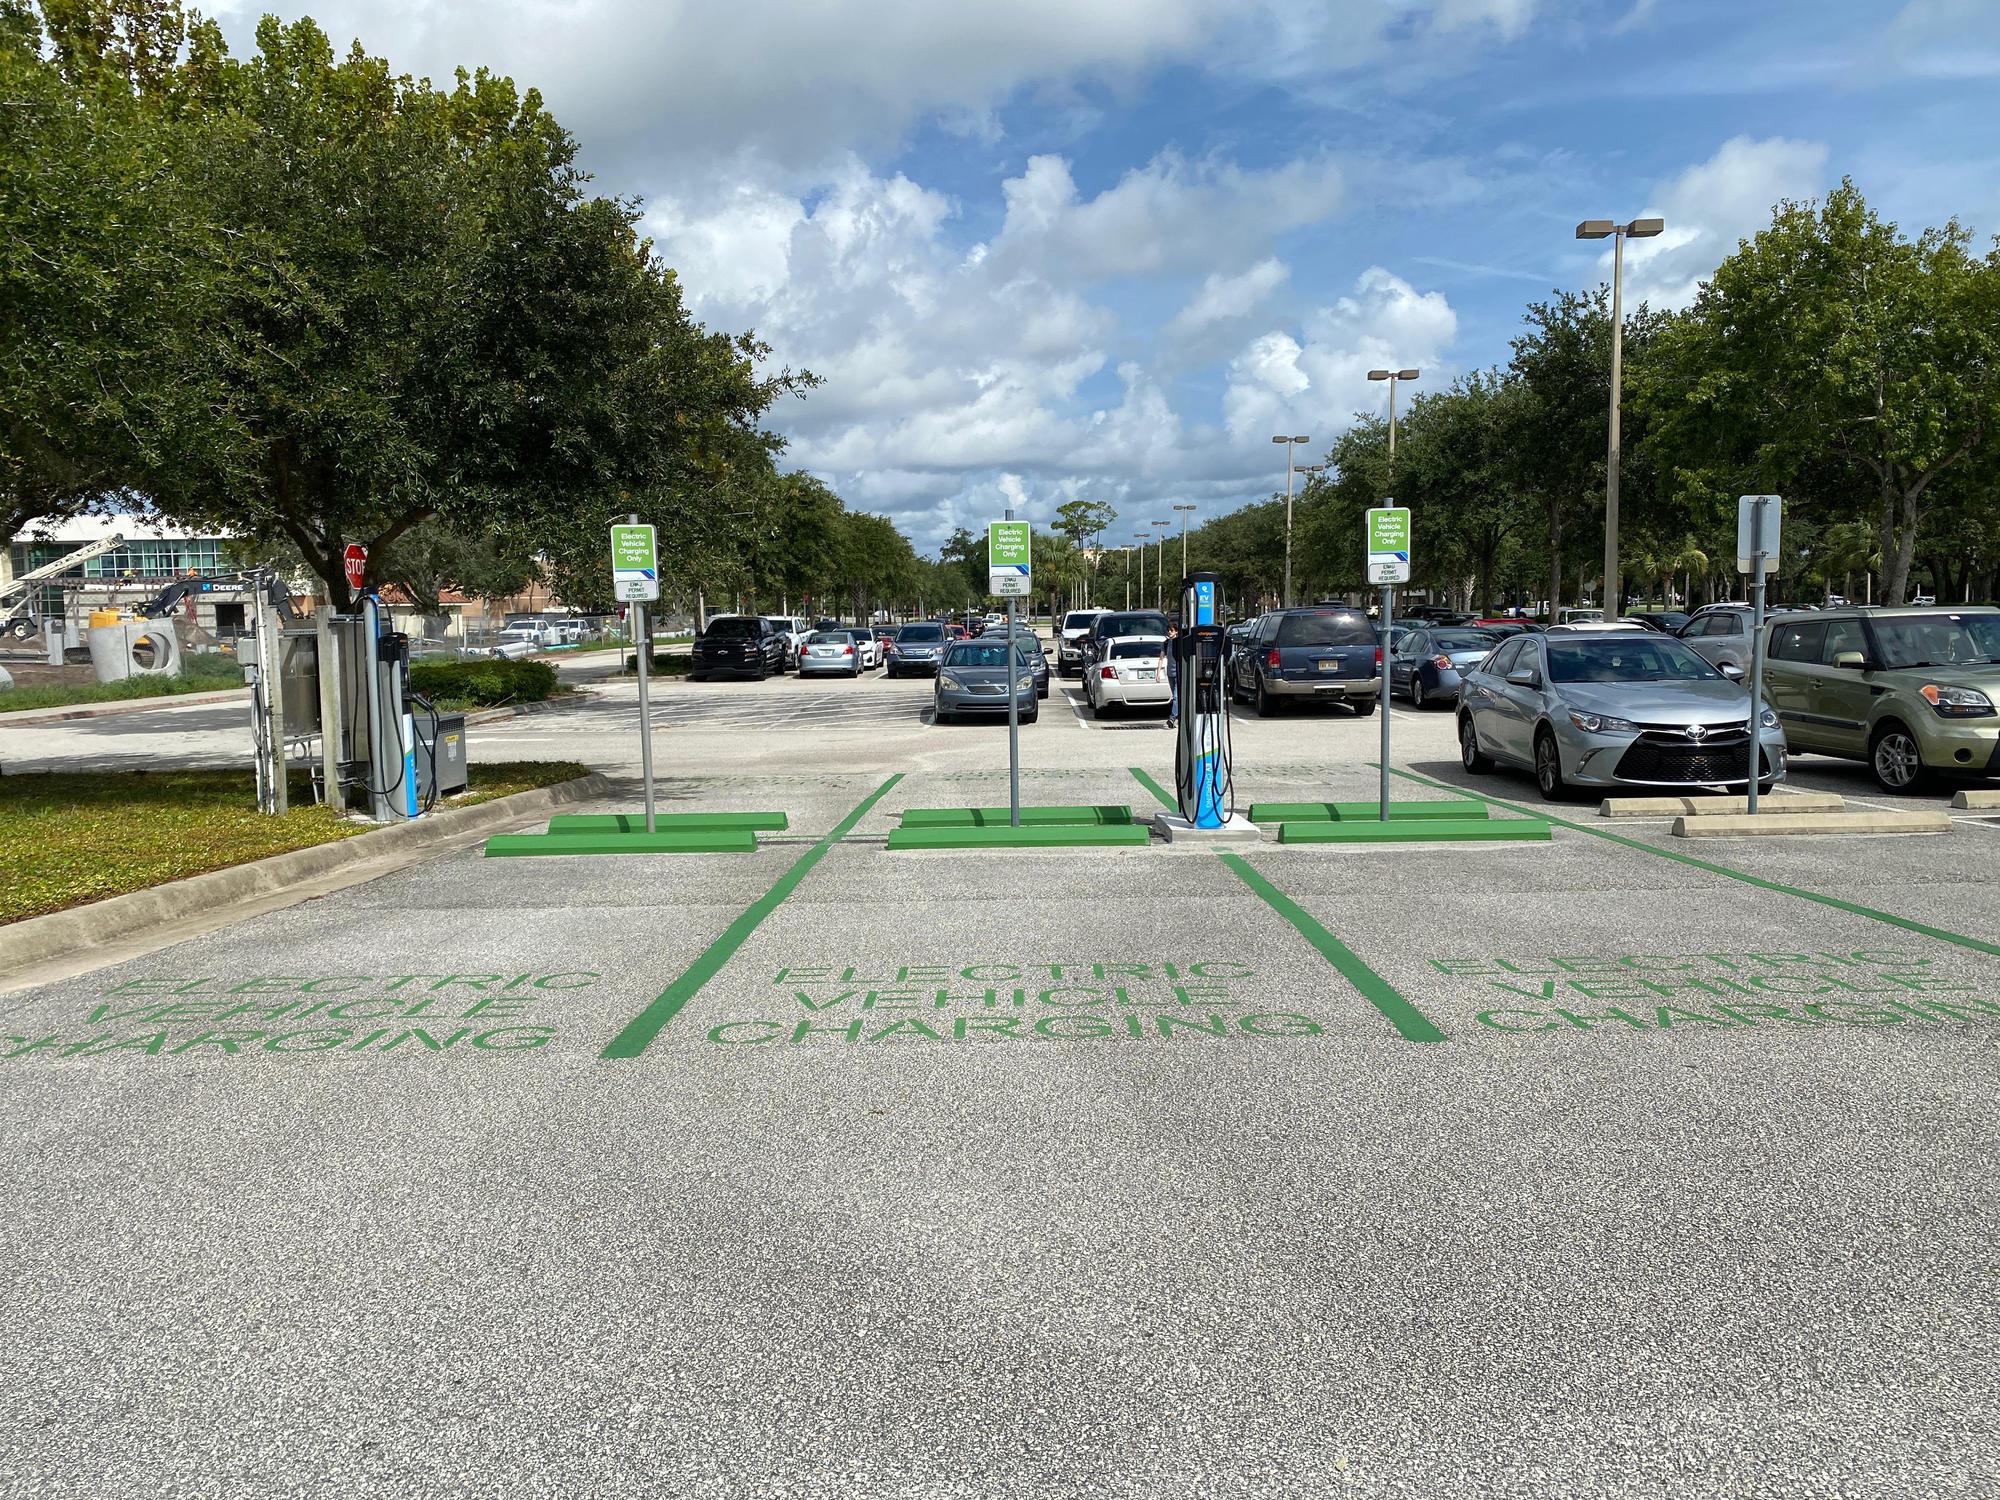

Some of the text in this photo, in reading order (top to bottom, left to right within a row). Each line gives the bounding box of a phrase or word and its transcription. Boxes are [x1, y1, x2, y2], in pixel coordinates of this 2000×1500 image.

[618, 548, 649, 556] Charging
[995, 543, 1024, 551] Charging
[347, 558, 366, 575] STOP
[772, 962, 1252, 986] ELECTRIC
[1428, 950, 1931, 976] ELECTRIC
[103, 972, 601, 996] ELECTRIC
[1490, 974, 1978, 1001] VEHICLE
[85, 998, 539, 1025] VEHICLE
[793, 986, 1240, 1012] VEHICLE
[1476, 999, 2000, 1031] CHARGIN
[707, 1013, 1321, 1044] CHARGING
[0, 1026, 556, 1058] HARGING
